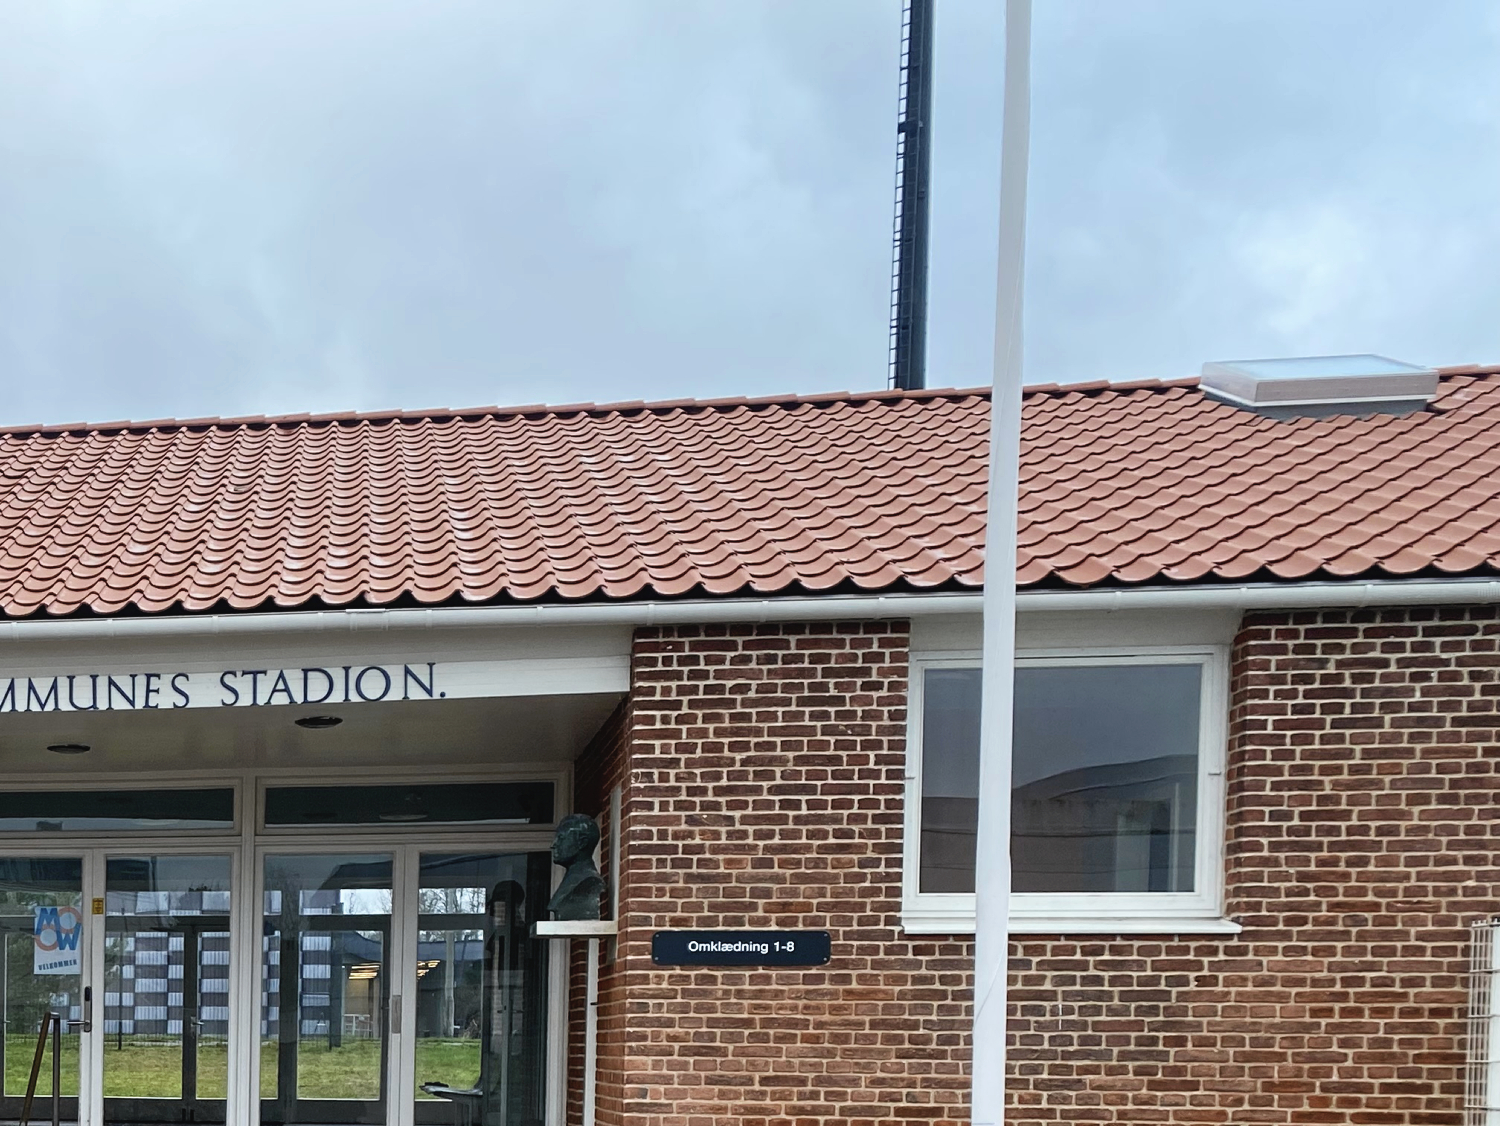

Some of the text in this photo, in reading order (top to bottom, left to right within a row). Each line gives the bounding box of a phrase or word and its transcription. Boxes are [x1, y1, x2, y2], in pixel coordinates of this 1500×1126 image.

[219, 662, 446, 708] STADION.
[688, 940, 795, 955] Omklædning 1-8
